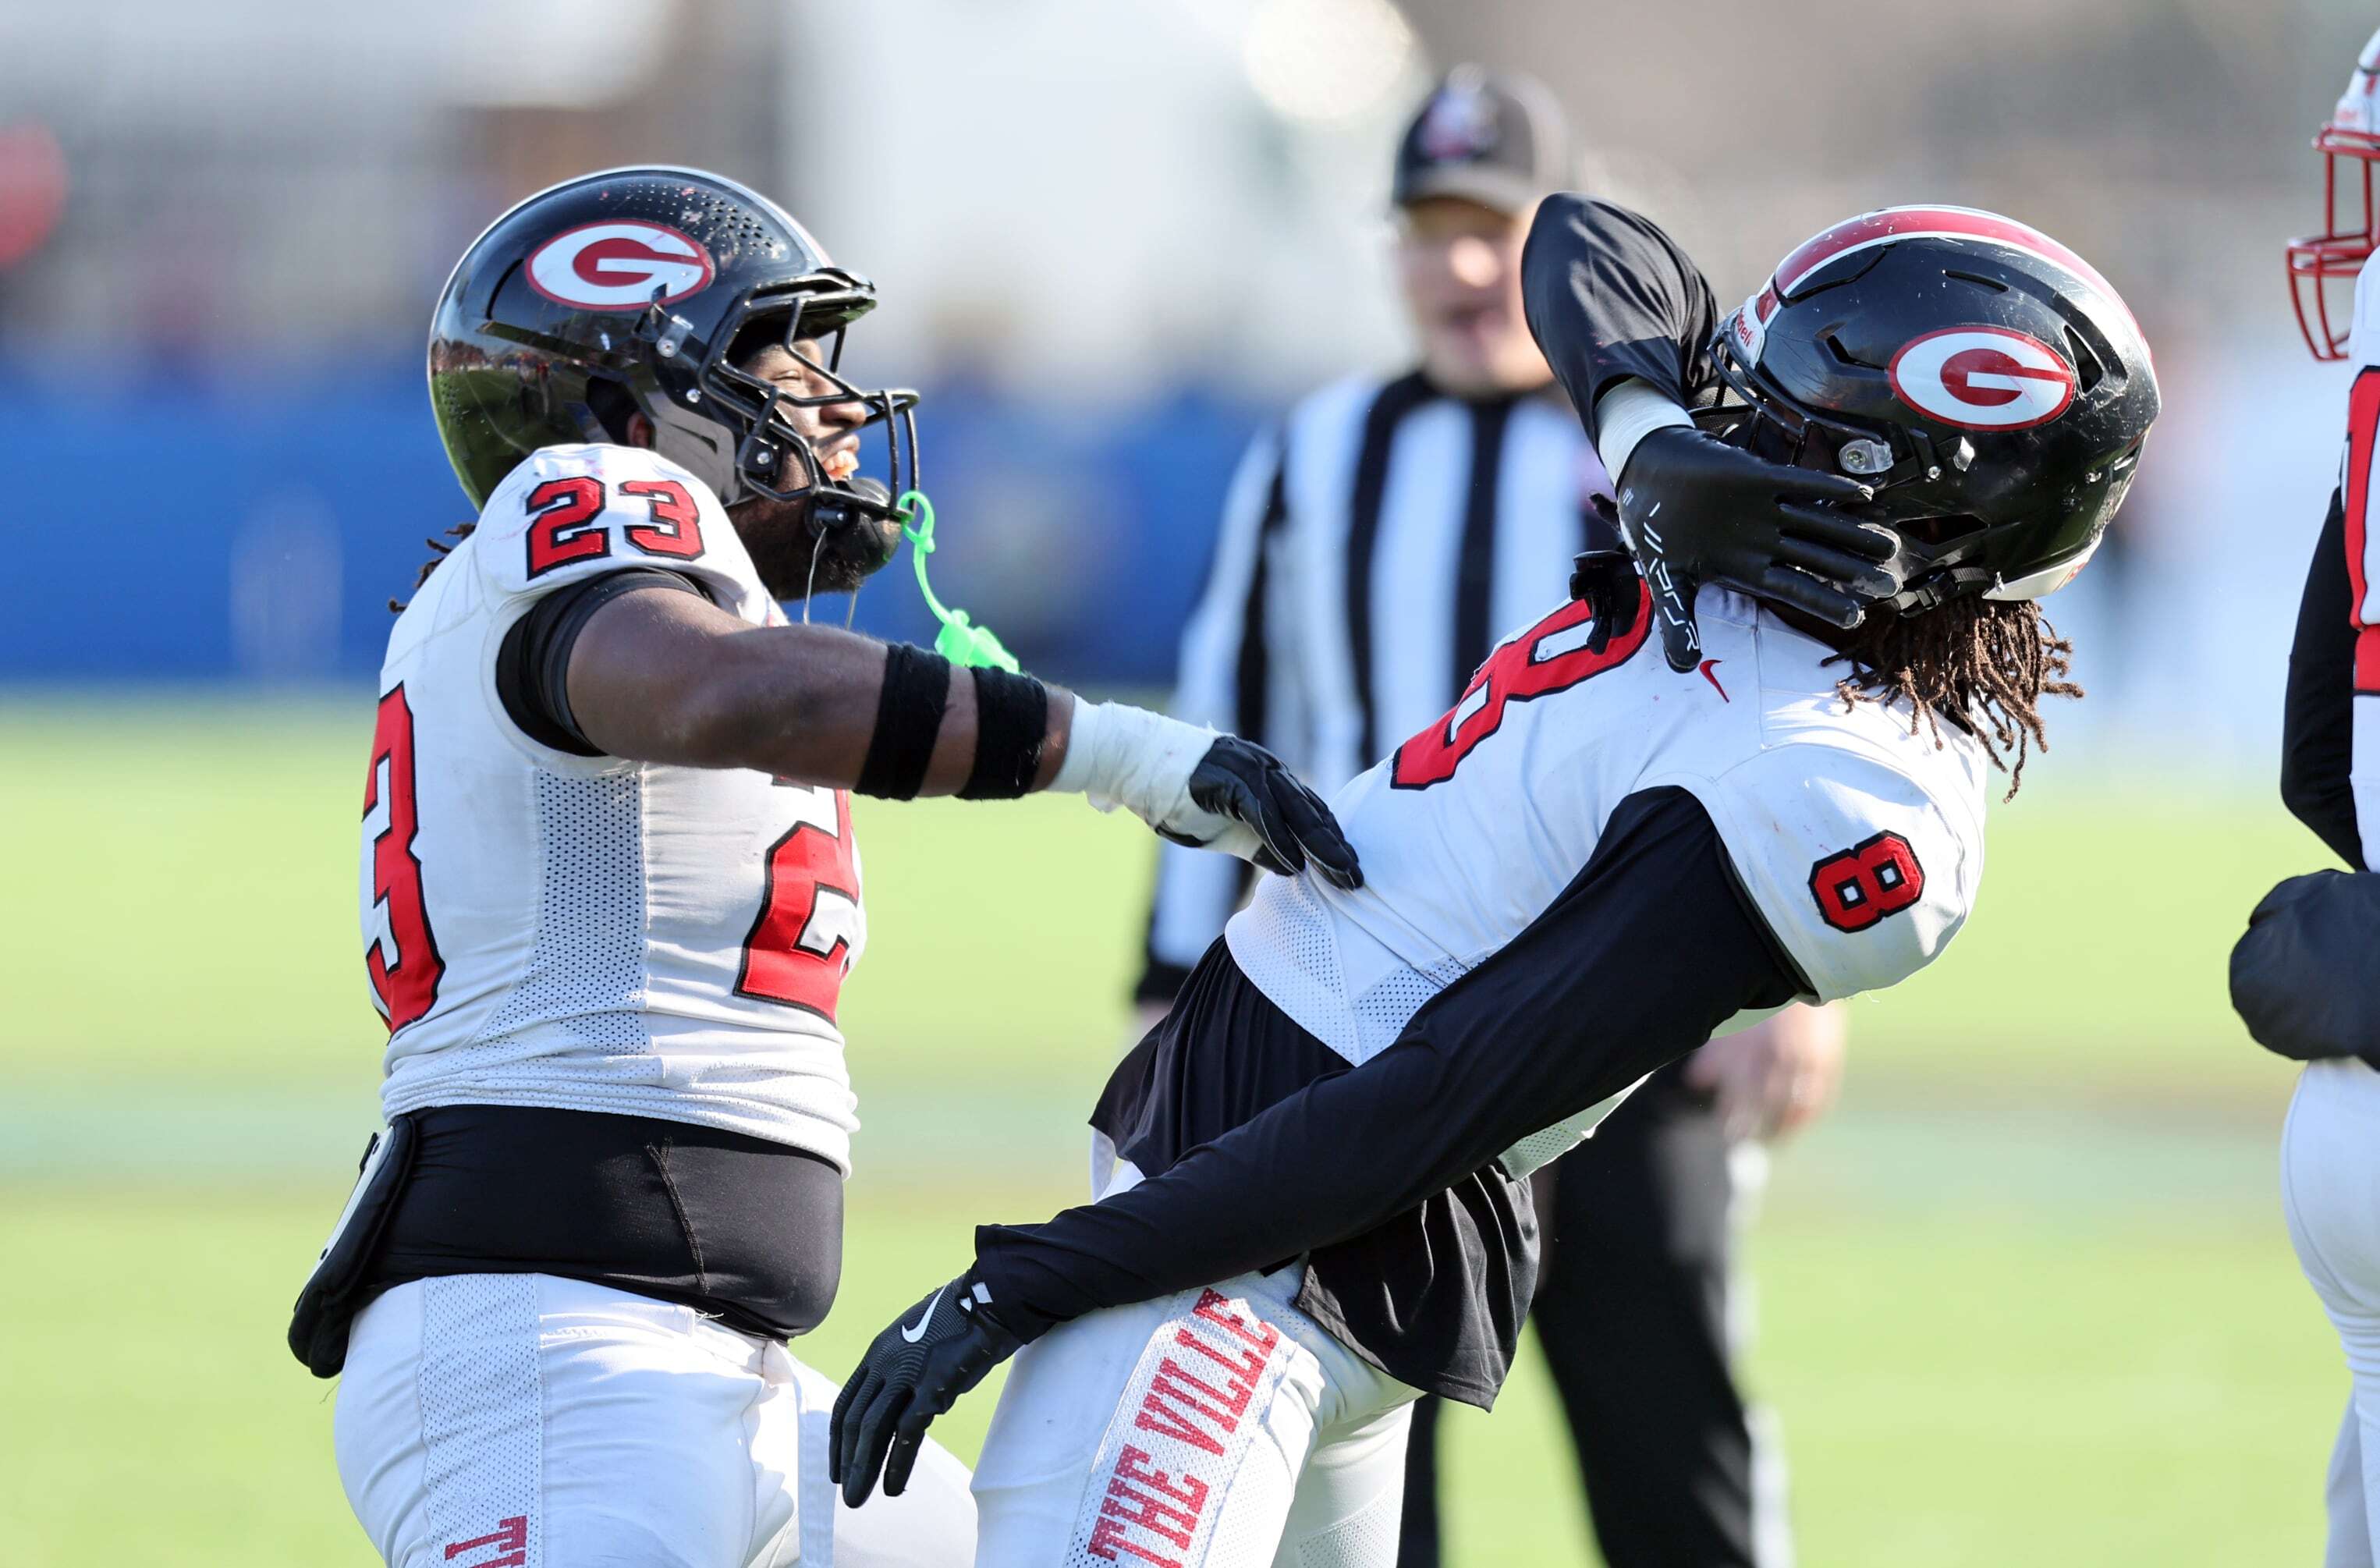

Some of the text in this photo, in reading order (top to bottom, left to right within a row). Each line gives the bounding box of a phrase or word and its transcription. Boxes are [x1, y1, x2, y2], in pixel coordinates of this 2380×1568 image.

[525, 220, 712, 310] G
[1890, 326, 2075, 431] G
[526, 477, 706, 581] 23
[1390, 576, 1655, 790] 8
[1808, 829, 1925, 933] 8
[1087, 1287, 1280, 1568] THE VILLE
